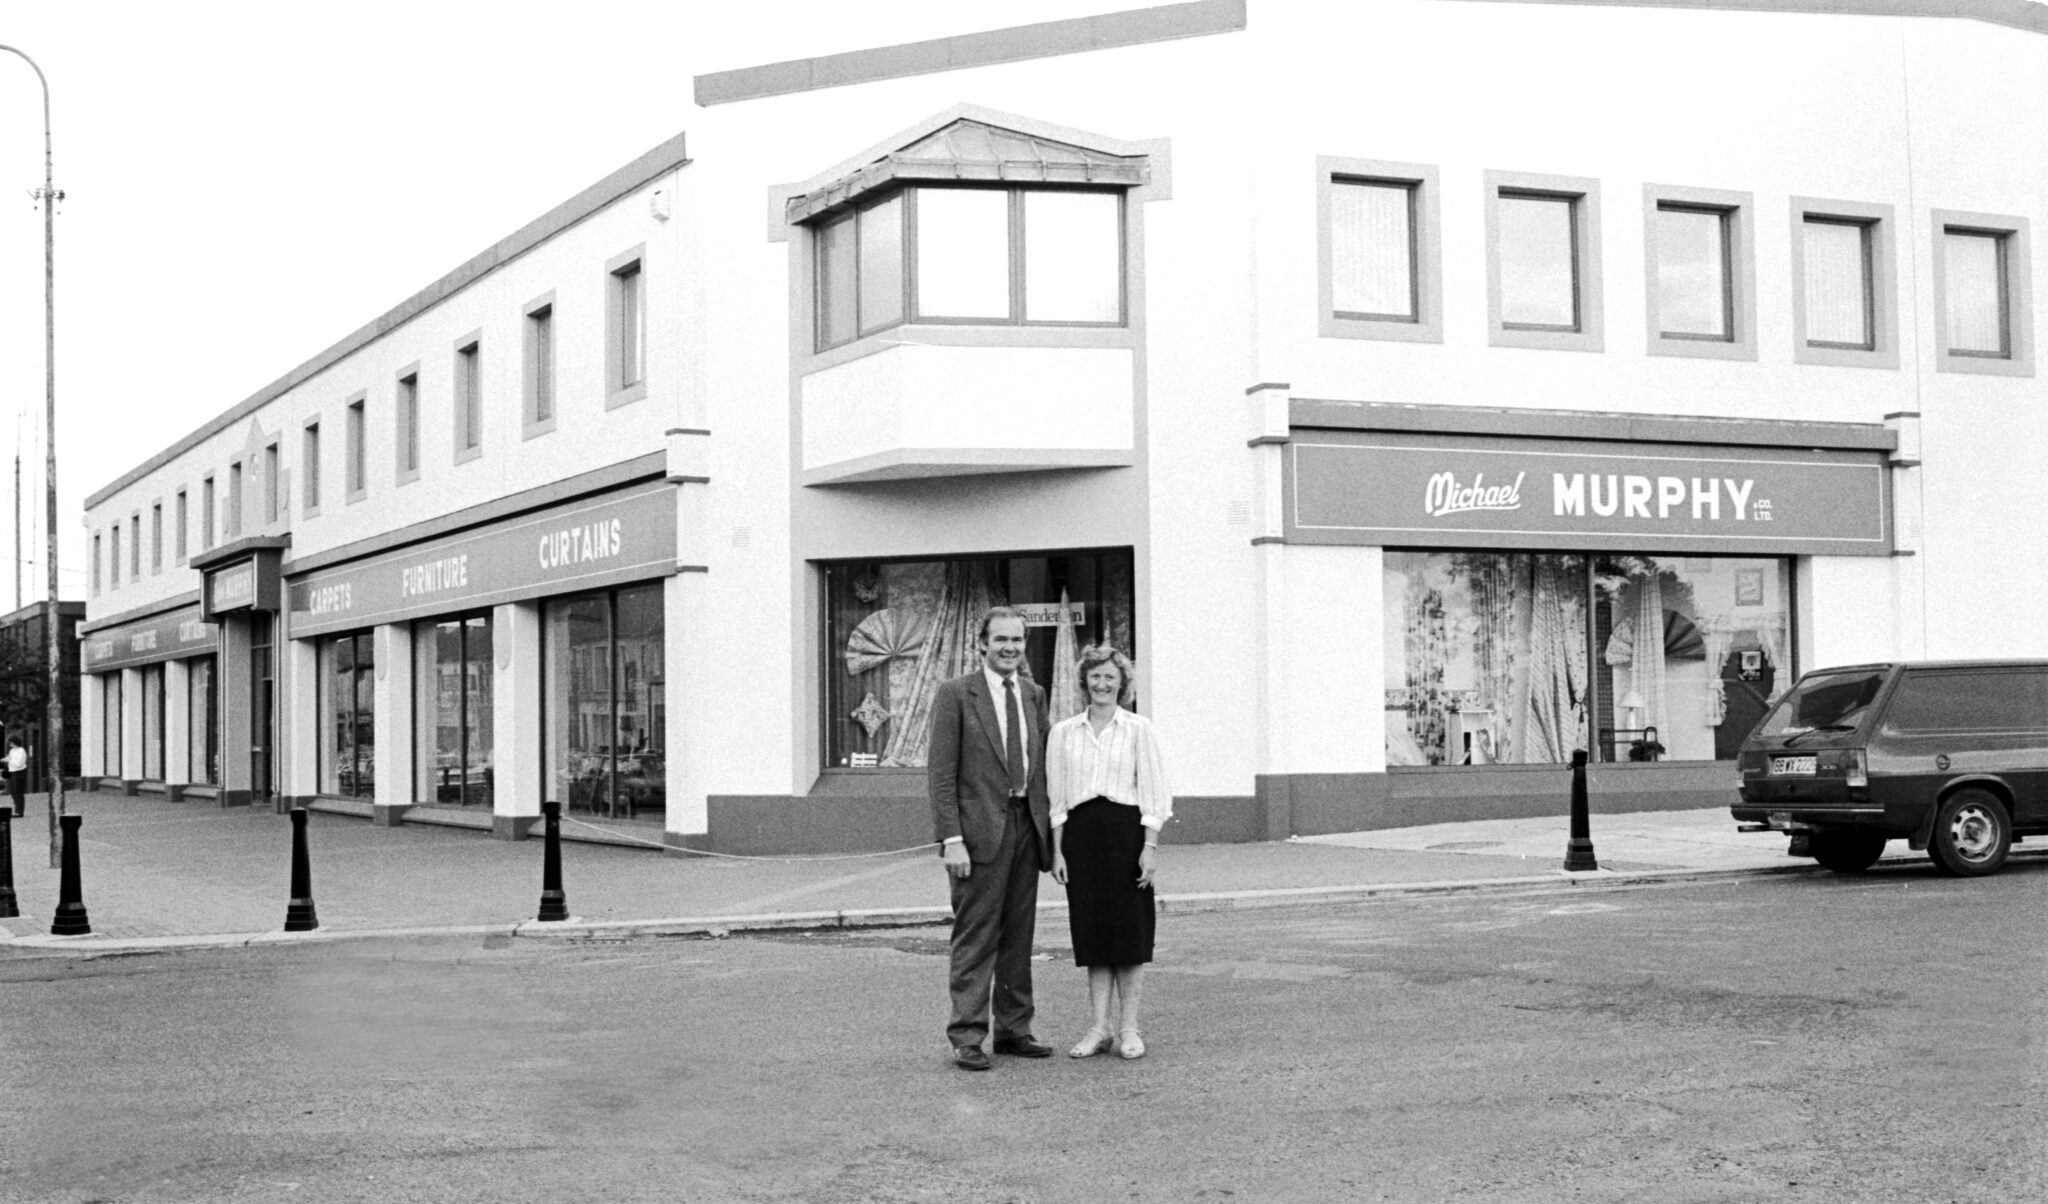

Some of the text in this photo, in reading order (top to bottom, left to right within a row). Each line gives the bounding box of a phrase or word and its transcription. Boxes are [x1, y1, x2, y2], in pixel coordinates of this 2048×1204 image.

[1425, 471, 1754, 520] Michael MURPHY
[309, 518, 622, 616] CARPETS FURNITURE CURTAINS
[1020, 608, 1083, 623] Sandern
